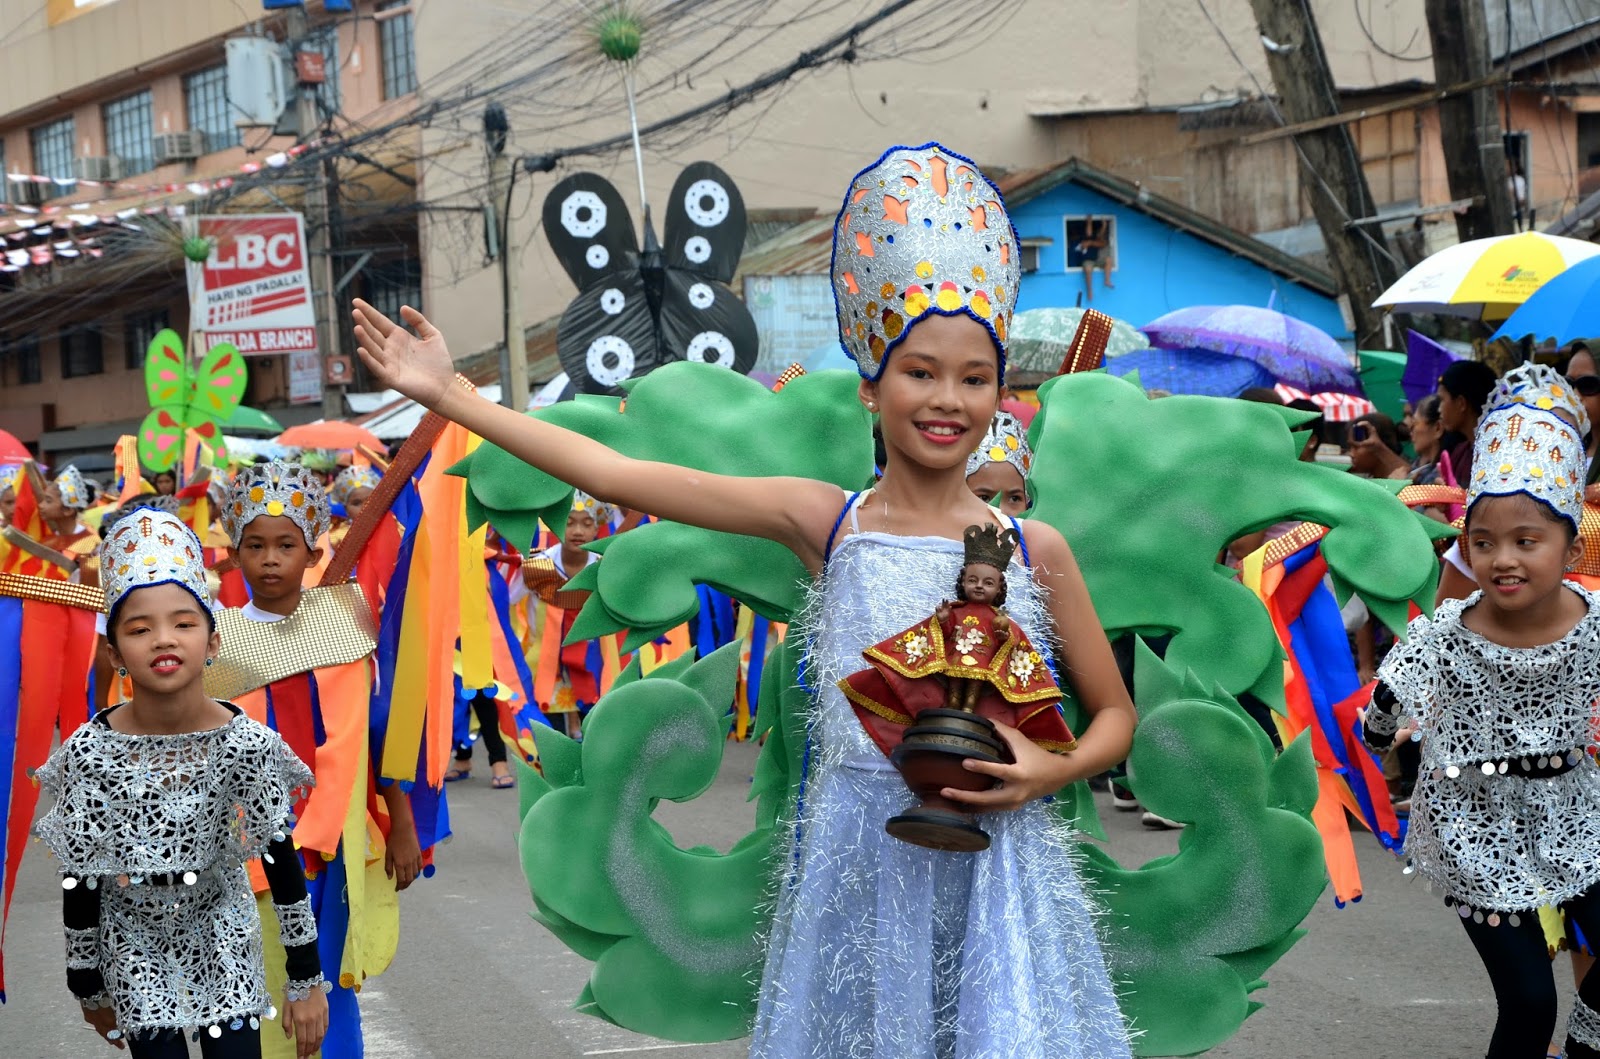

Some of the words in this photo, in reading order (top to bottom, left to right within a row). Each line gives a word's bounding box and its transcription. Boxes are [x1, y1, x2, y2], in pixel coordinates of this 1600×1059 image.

[204, 233, 295, 270] LBC
[207, 291, 234, 303] HARI
[236, 285, 253, 298] NG
[256, 274, 303, 293] PADALA!
[259, 329, 312, 349] BRANCH
